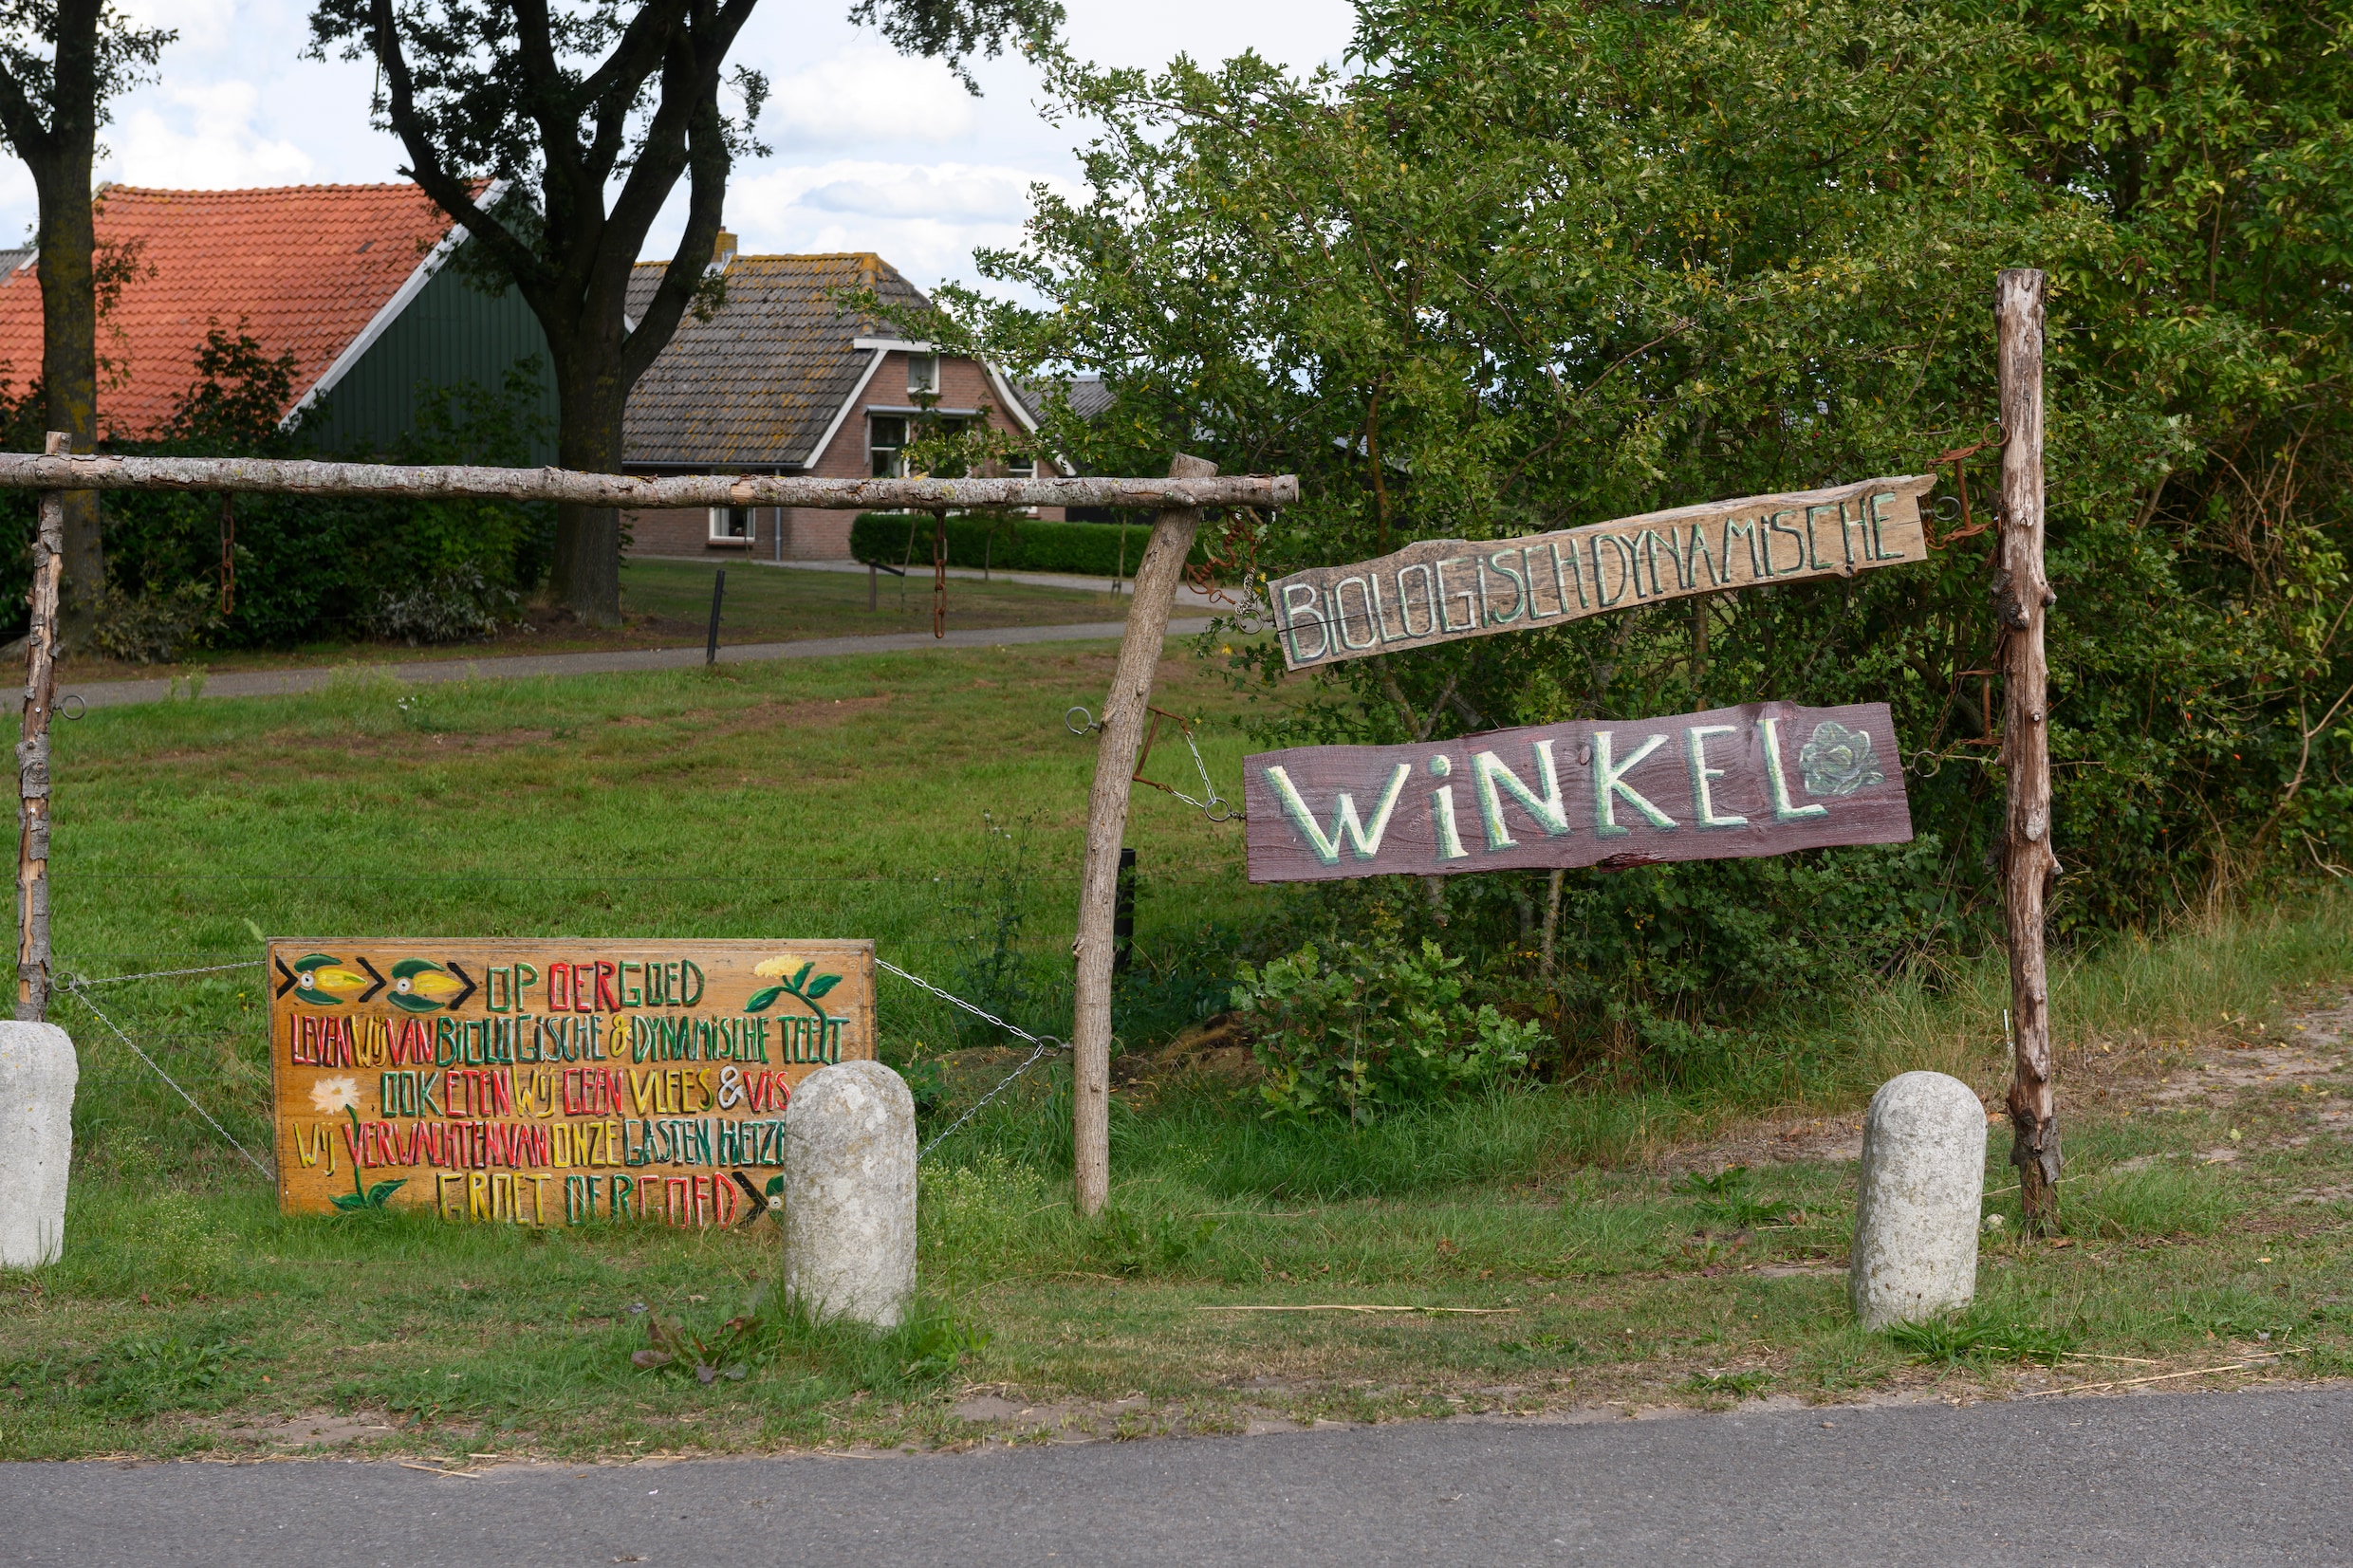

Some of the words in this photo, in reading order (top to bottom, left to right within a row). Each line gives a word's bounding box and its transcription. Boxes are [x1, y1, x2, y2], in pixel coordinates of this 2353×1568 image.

[1262, 717, 1828, 864] WiNKEL
[488, 963, 540, 1012] OP
[610, 1014, 631, 1058] &
[380, 1070, 443, 1116] OOK
[445, 1069, 510, 1116] ETEN
[563, 1068, 623, 1116] GEEN
[629, 1068, 714, 1116] VLEES
[718, 1065, 744, 1109] &
[553, 1121, 621, 1168] ONZE
[623, 1119, 713, 1167] GASTEN
[436, 1172, 552, 1225] GROET
